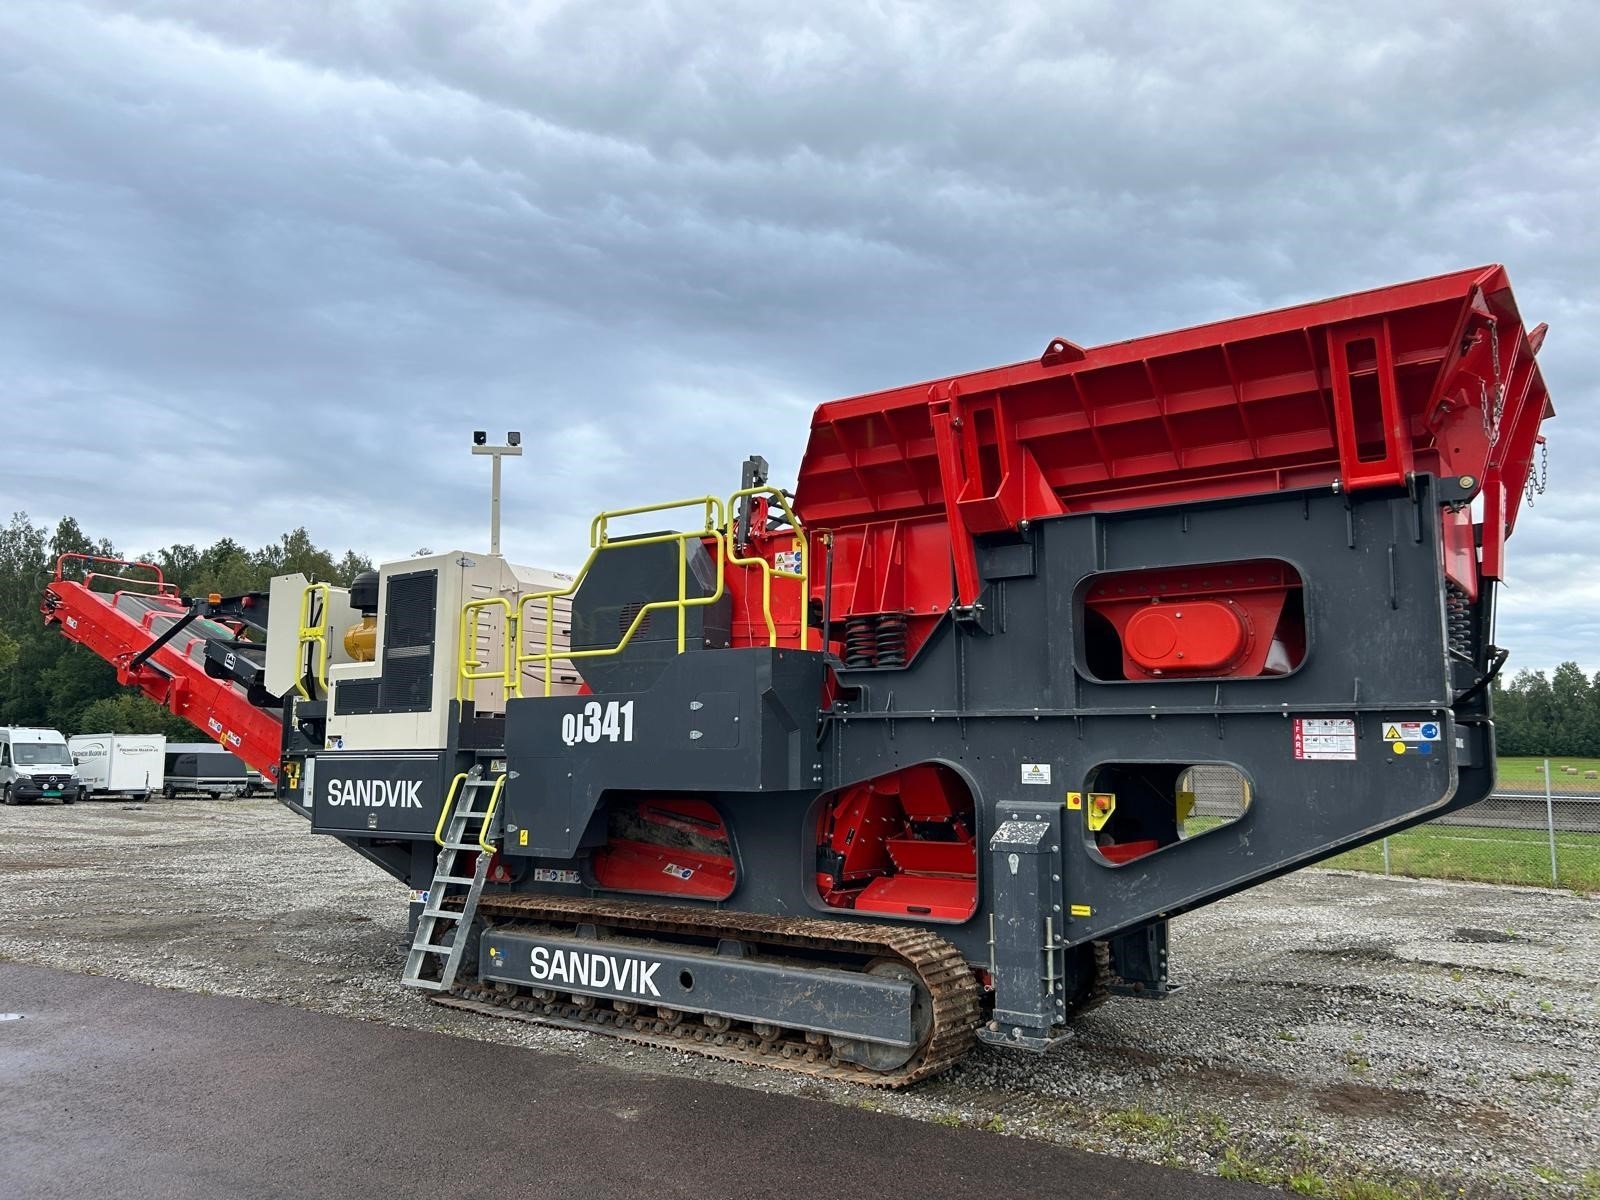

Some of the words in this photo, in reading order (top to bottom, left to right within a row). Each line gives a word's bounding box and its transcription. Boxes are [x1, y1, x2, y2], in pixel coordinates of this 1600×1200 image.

[561, 700, 634, 746] QJ341
[327, 779, 423, 808] SANDVIK
[530, 946, 661, 997] SANDVIK
